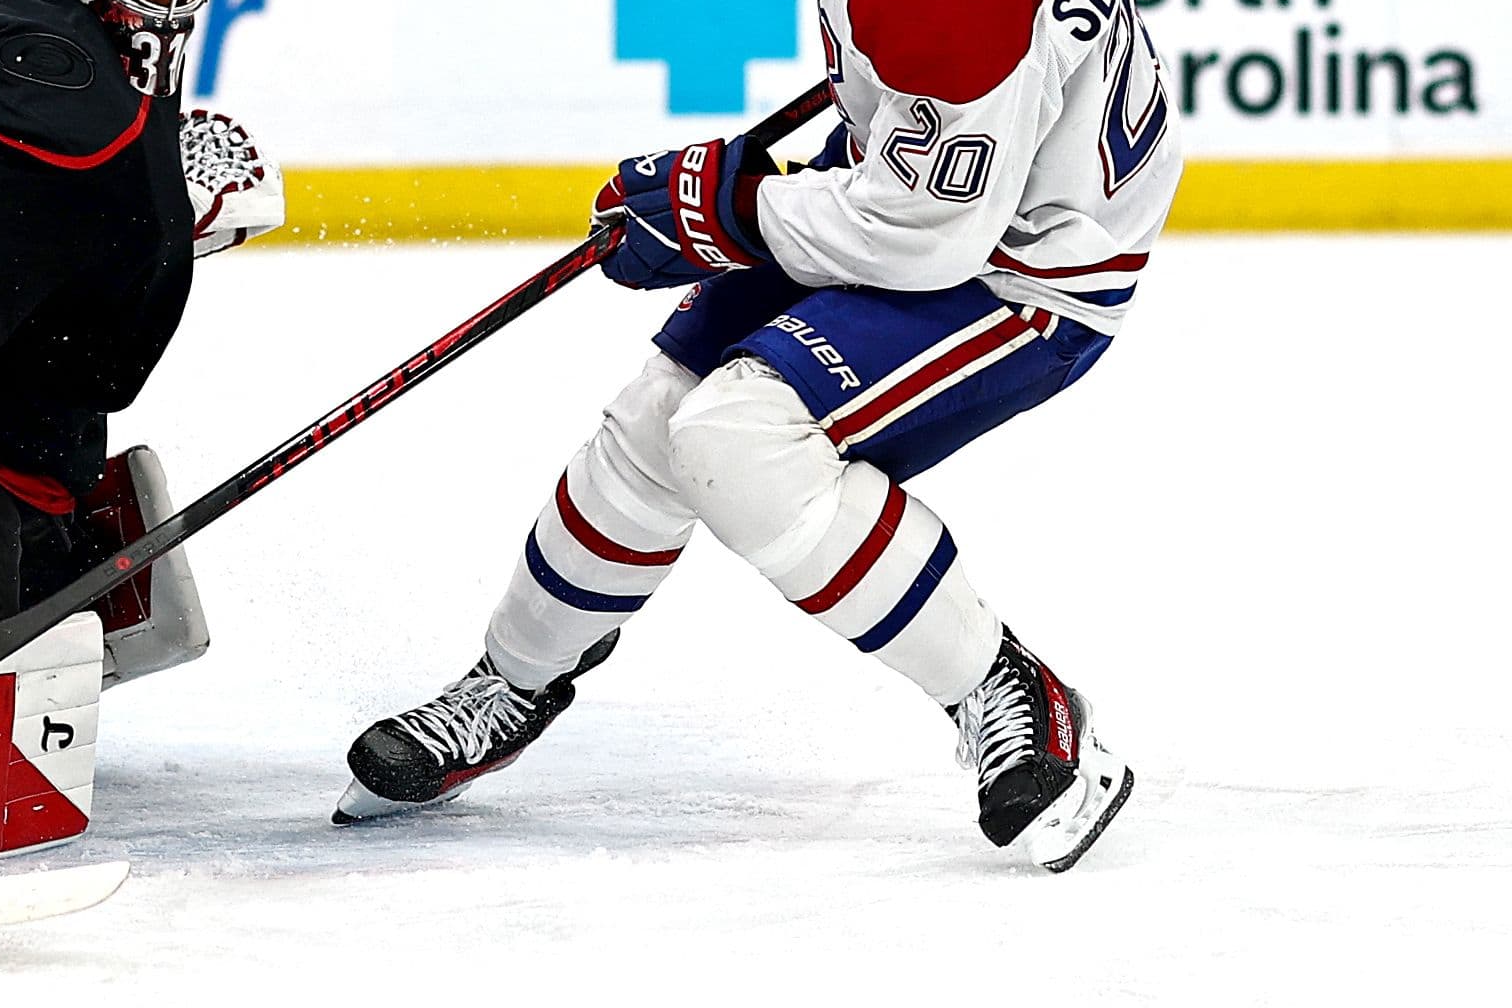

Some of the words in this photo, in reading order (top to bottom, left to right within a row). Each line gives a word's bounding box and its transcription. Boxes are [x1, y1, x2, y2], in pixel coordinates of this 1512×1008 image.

[130, 31, 187, 98] 31
[1179, 22, 1478, 115] rolina
[880, 98, 997, 203] 20
